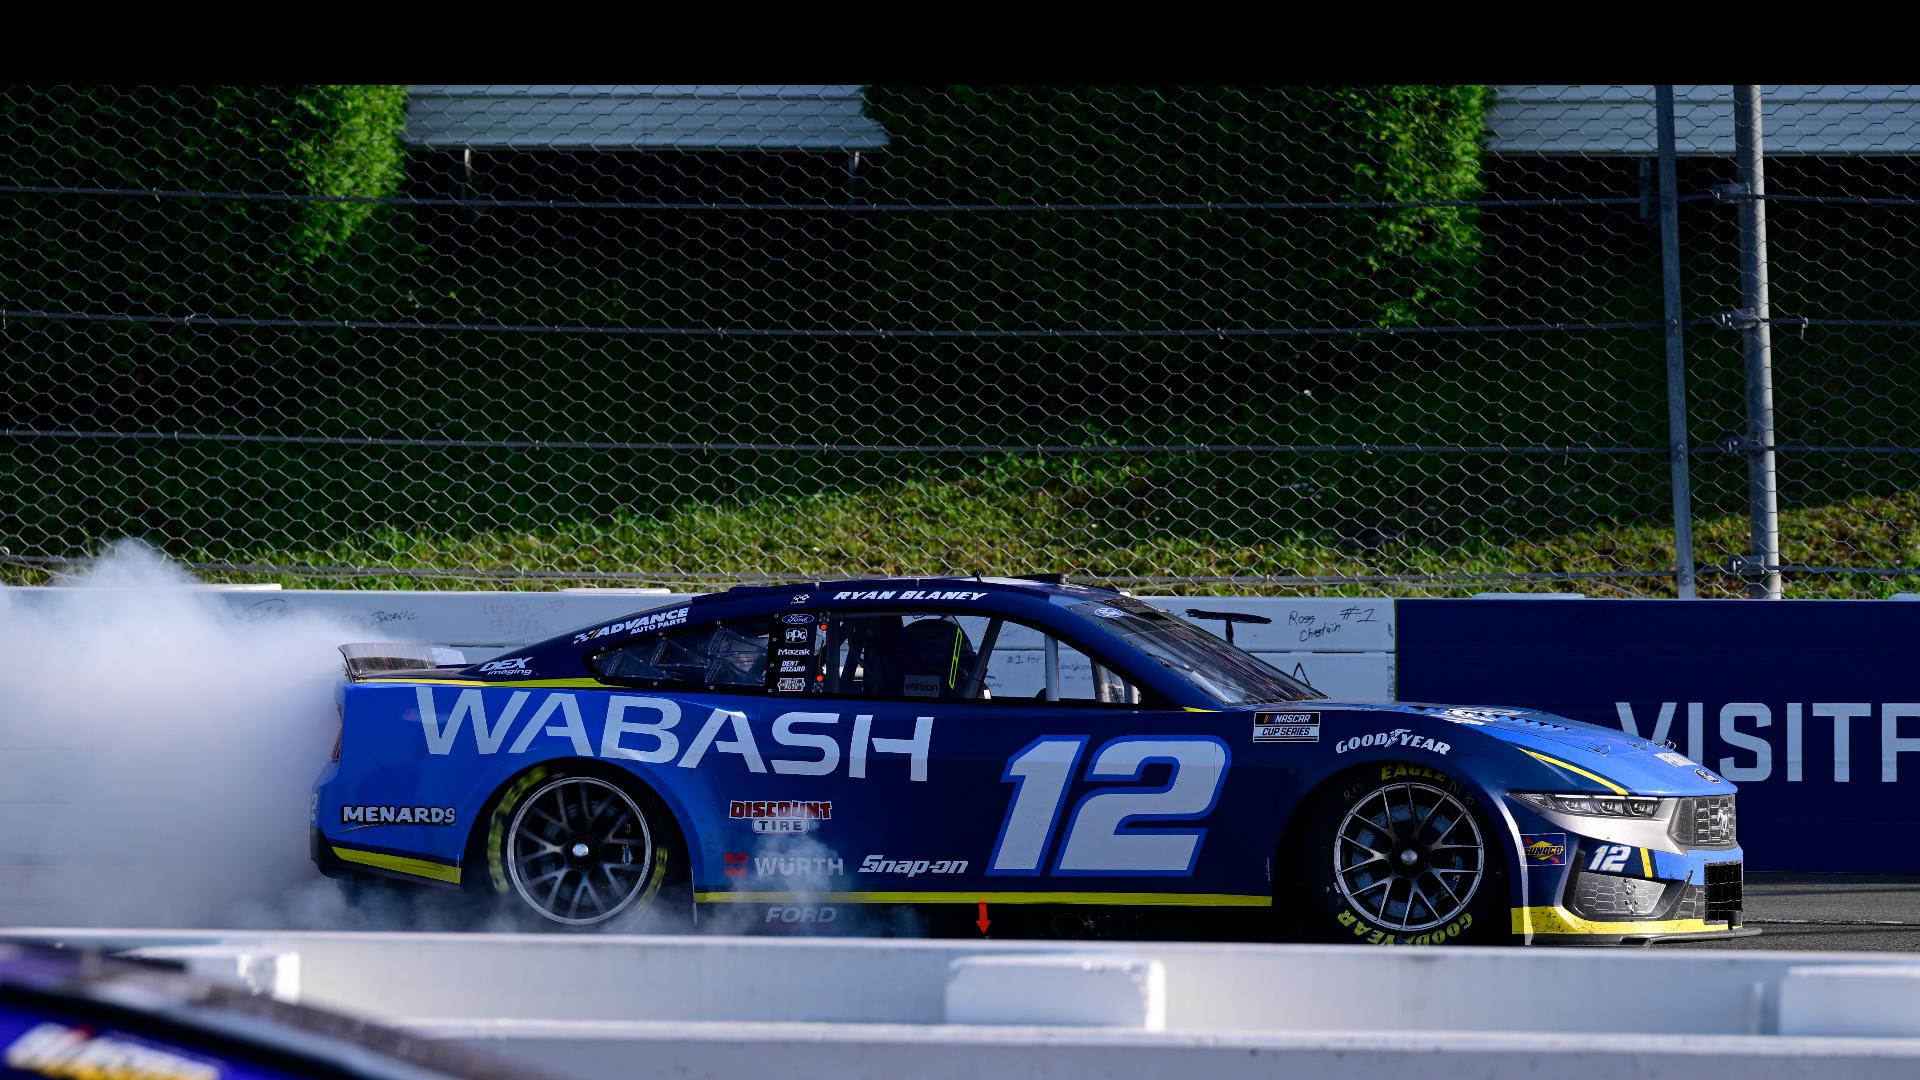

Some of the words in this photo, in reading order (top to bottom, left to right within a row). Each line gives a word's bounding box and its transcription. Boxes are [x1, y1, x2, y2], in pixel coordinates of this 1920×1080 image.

[833, 590, 896, 600] RYAN
[899, 590, 988, 601] BLANEY
[594, 607, 690, 637] ADVANCE
[630, 623, 657, 635] AUTO
[657, 617, 688, 629] PARTS
[1288, 610, 1316, 626] Ross
[778, 648, 811, 656] Mazak
[479, 656, 533, 672] DEX
[487, 666, 533, 676] imaging
[1274, 714, 1311, 723] NASCAR
[415, 686, 935, 782] WABASH
[1262, 727, 1279, 736] CUP
[1281, 726, 1311, 736] SERIES
[1335, 728, 1451, 755] GOODYEAR
[1381, 763, 1447, 781] EAGLE
[729, 799, 832, 820] DISCOUNT
[985, 735, 1232, 877] 12
[341, 805, 456, 826] MENARDS
[757, 820, 803, 831] TIRE
[1524, 845, 1564, 855] SUNOCO
[1588, 844, 1632, 873] 12
[754, 857, 844, 876] WÜRTH
[858, 854, 969, 878] Snap-on
[765, 906, 838, 924] FORD
